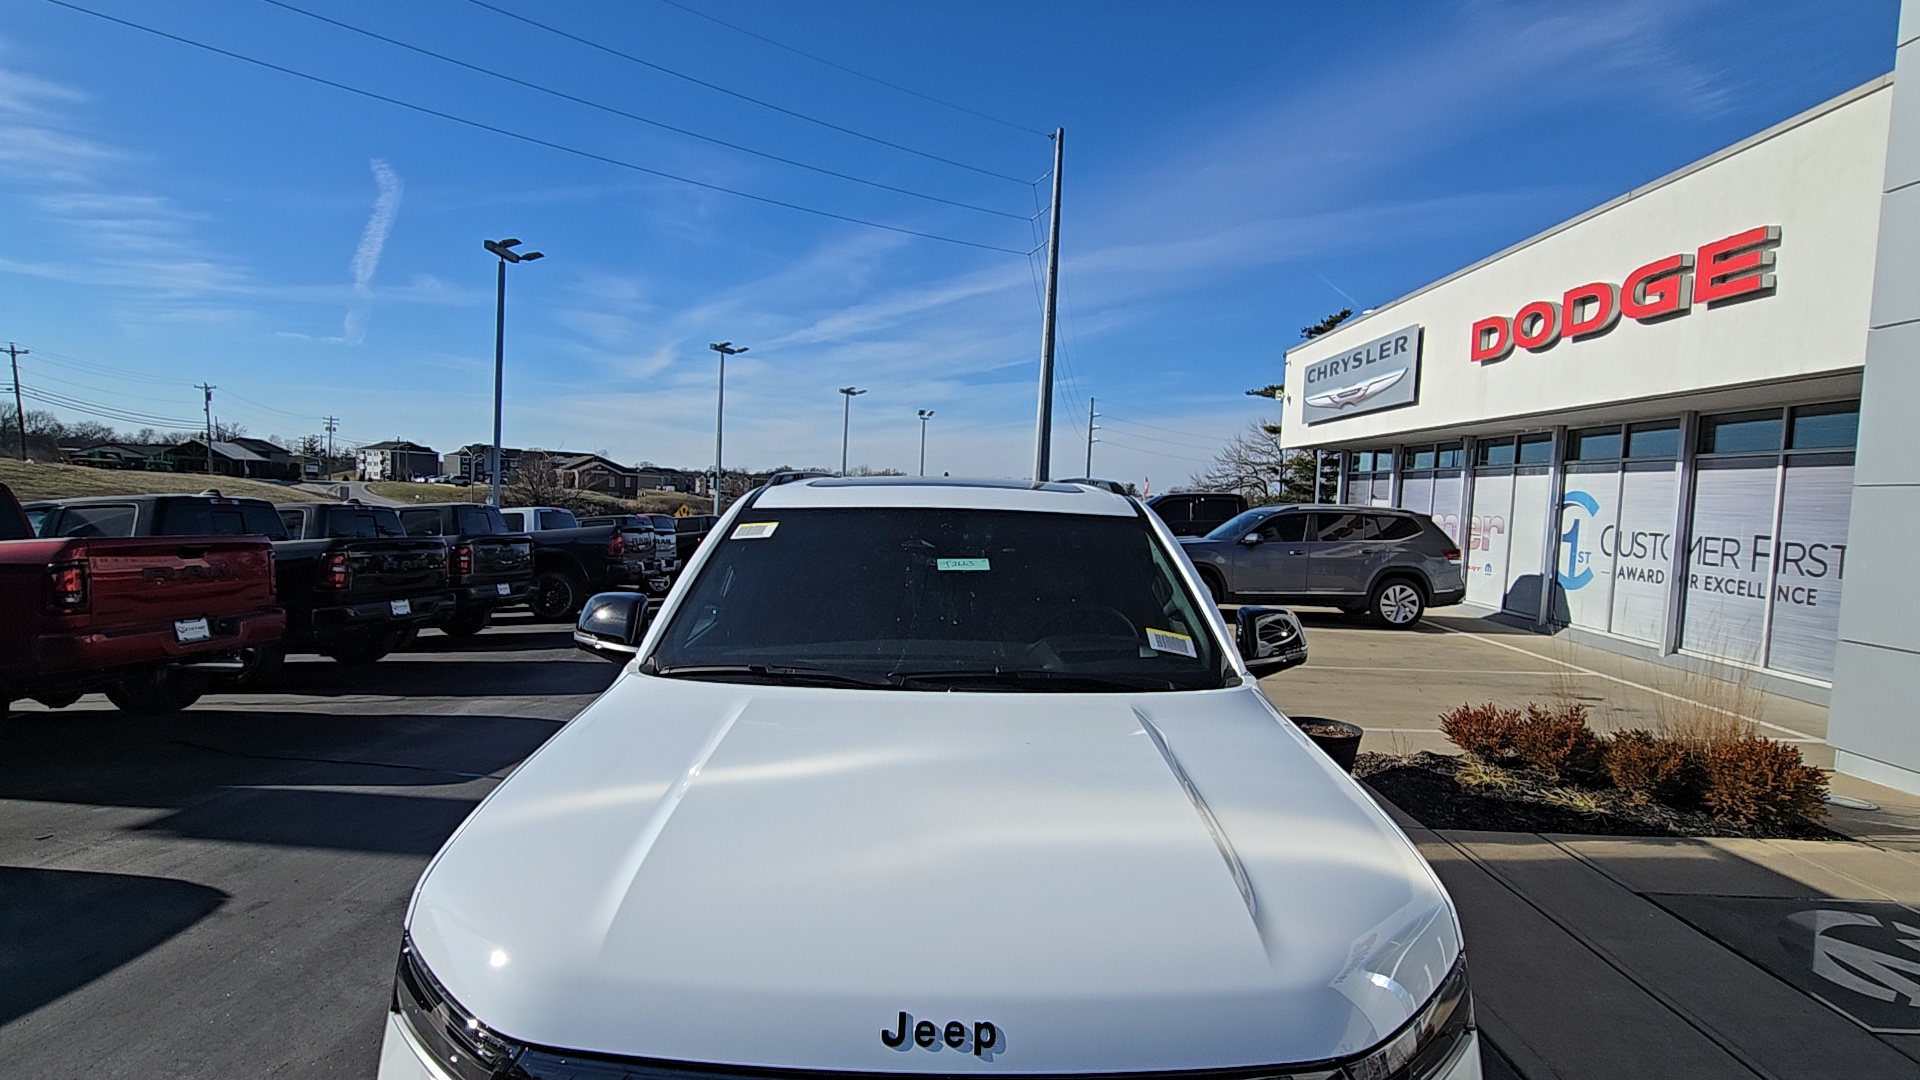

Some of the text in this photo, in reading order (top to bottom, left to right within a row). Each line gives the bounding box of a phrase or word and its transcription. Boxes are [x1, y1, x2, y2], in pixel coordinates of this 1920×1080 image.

[1471, 226, 1780, 362] DODGE
[1307, 335, 1408, 384] CHRYSLER
[143, 565, 238, 582] RAM
[1617, 565, 1665, 584] AWARD
[1704, 575, 1818, 607] EXCELLNCE
[881, 1011, 997, 1056] Jeep
